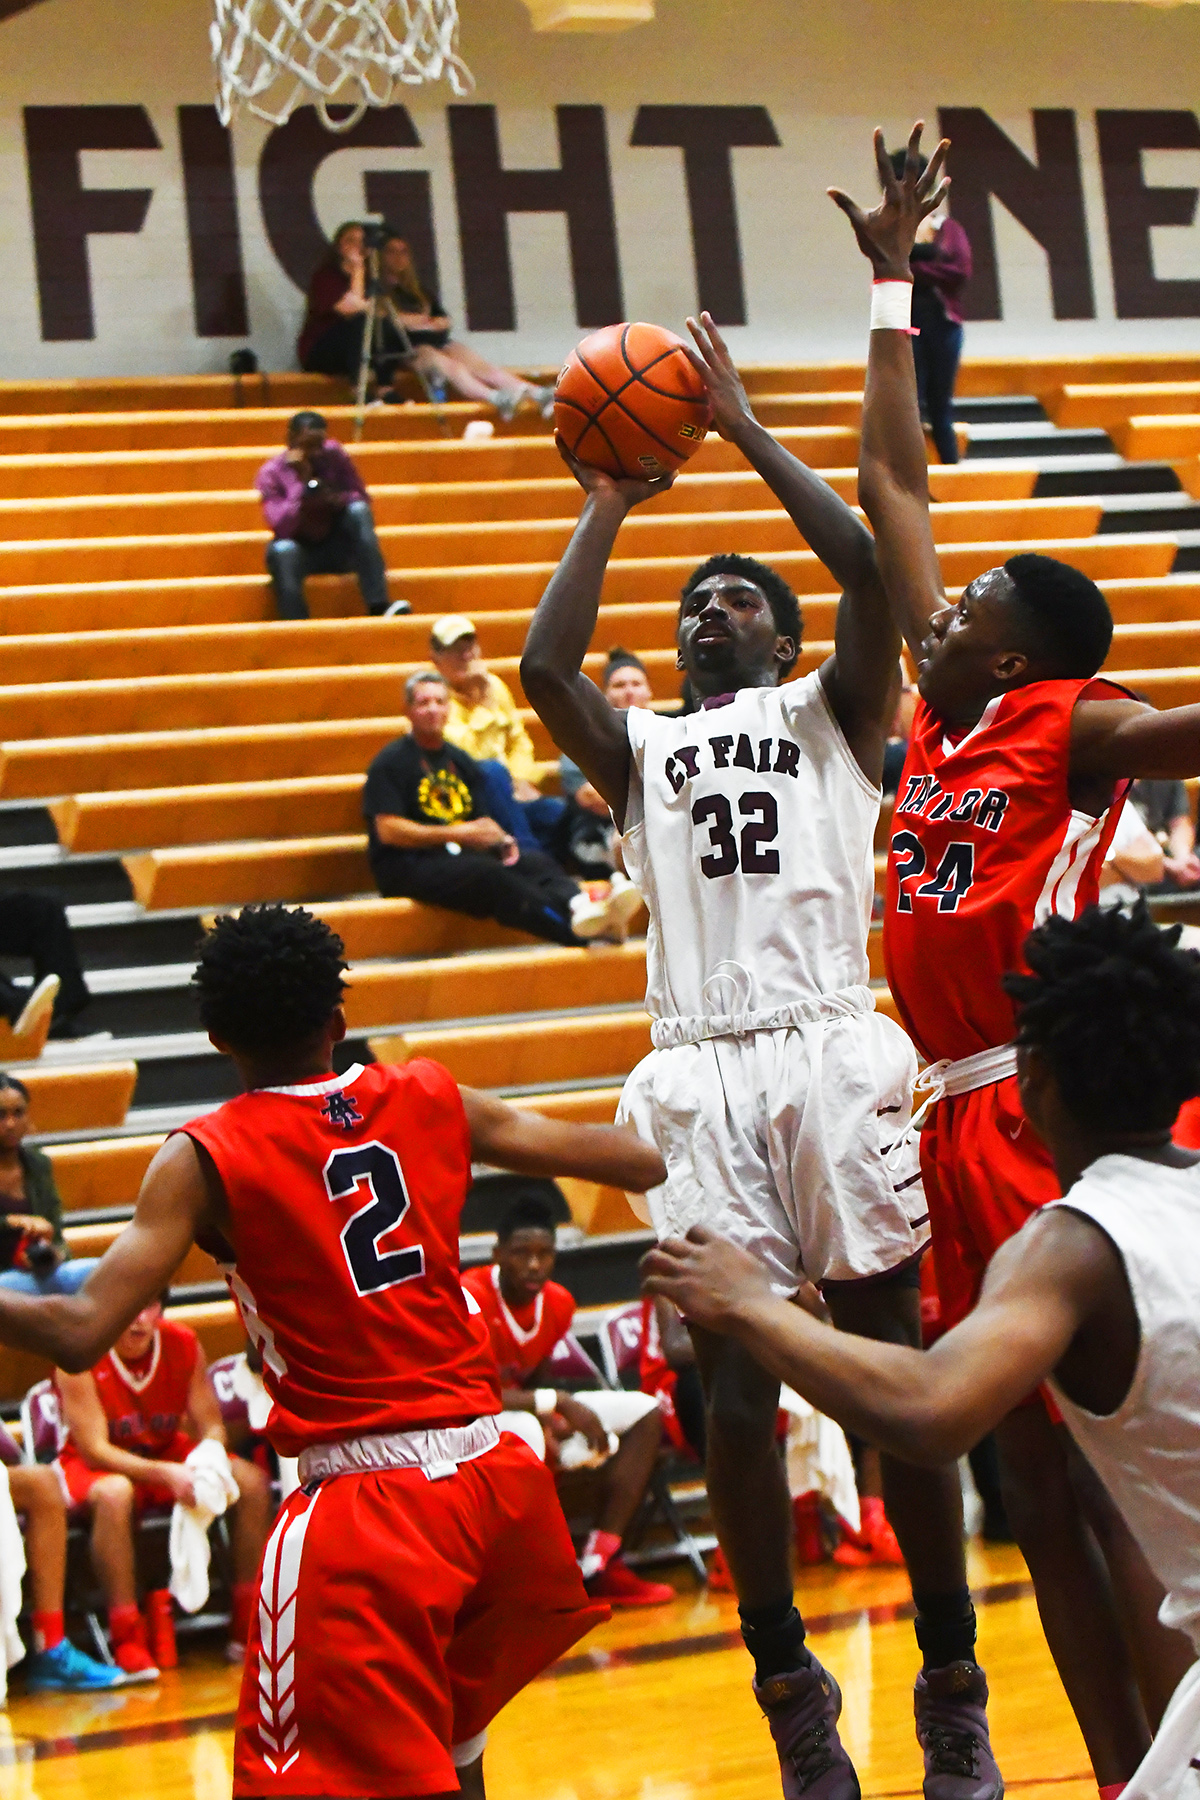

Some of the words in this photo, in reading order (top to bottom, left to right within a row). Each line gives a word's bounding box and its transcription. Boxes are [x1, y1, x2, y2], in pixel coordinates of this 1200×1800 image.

[23, 104, 781, 341] FIGHT
[937, 107, 1200, 320] NE
[664, 745, 701, 795] CY
[708, 733, 801, 779] FAIR
[896, 774, 1010, 833] TAYLOR
[691, 791, 780, 879] 32
[891, 829, 975, 914] 24
[322, 1139, 426, 1297] 2
